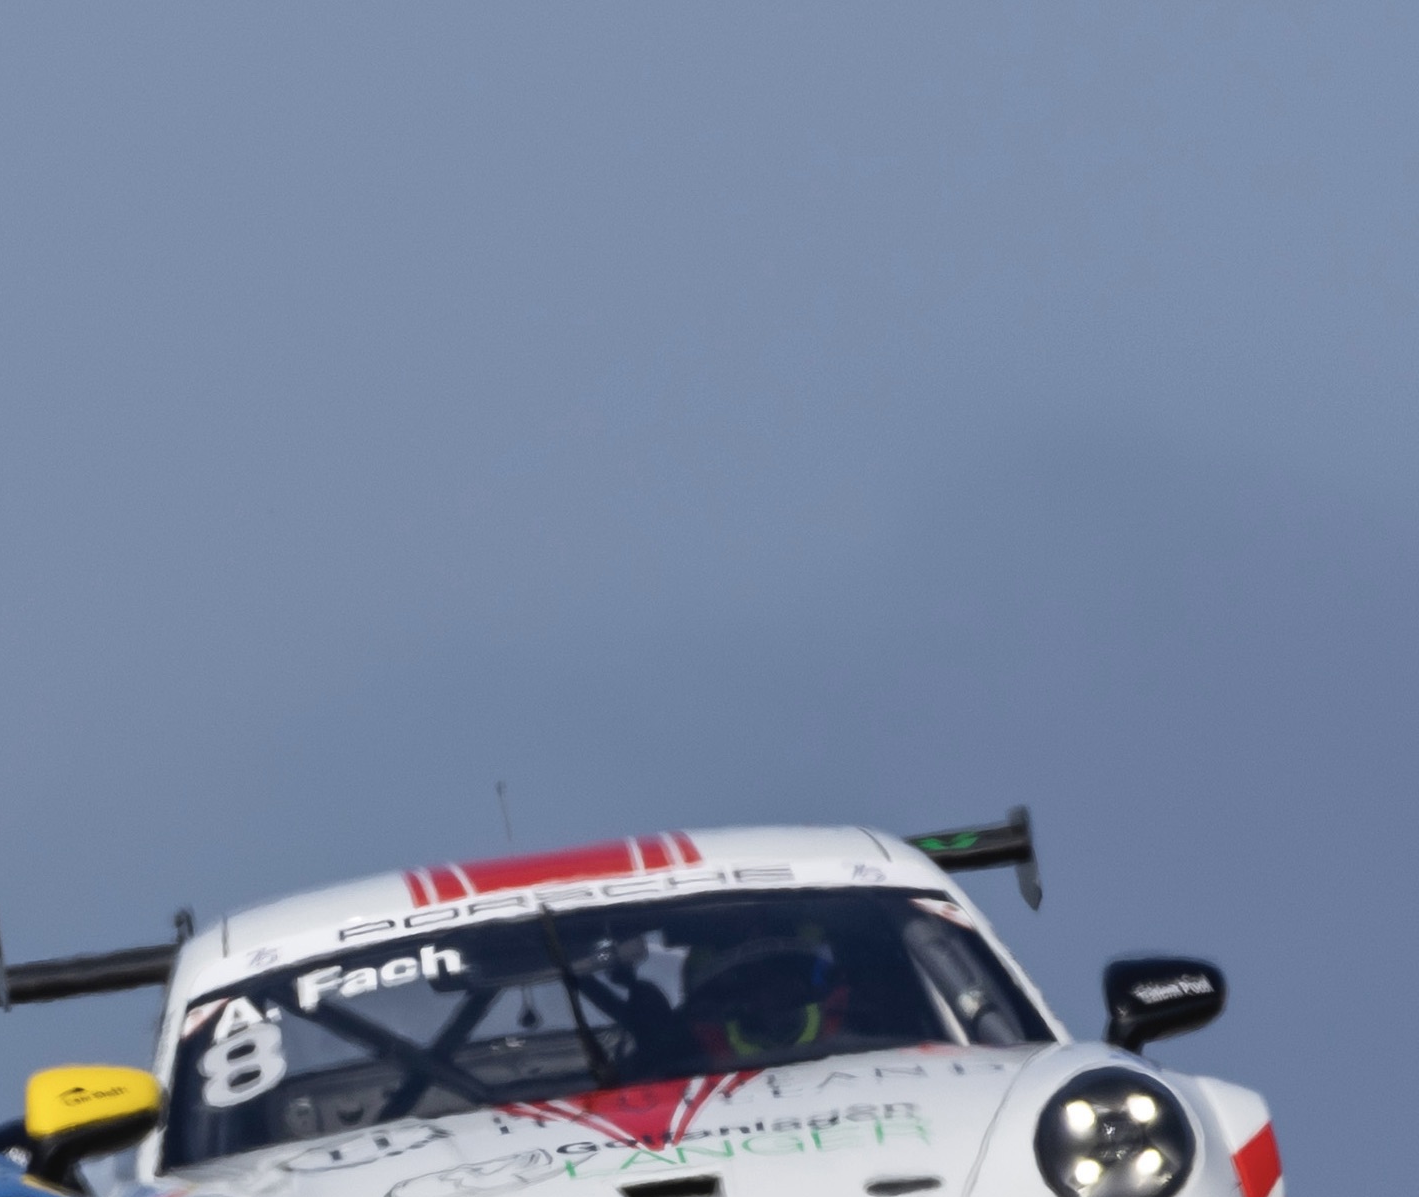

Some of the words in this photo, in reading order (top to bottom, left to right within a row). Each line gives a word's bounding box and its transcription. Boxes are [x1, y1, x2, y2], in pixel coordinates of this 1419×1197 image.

[339, 864, 794, 942] PORSCHE
[213, 997, 281, 1043] A.
[296, 945, 463, 1012] Fach
[199, 1021, 288, 1108] 8
